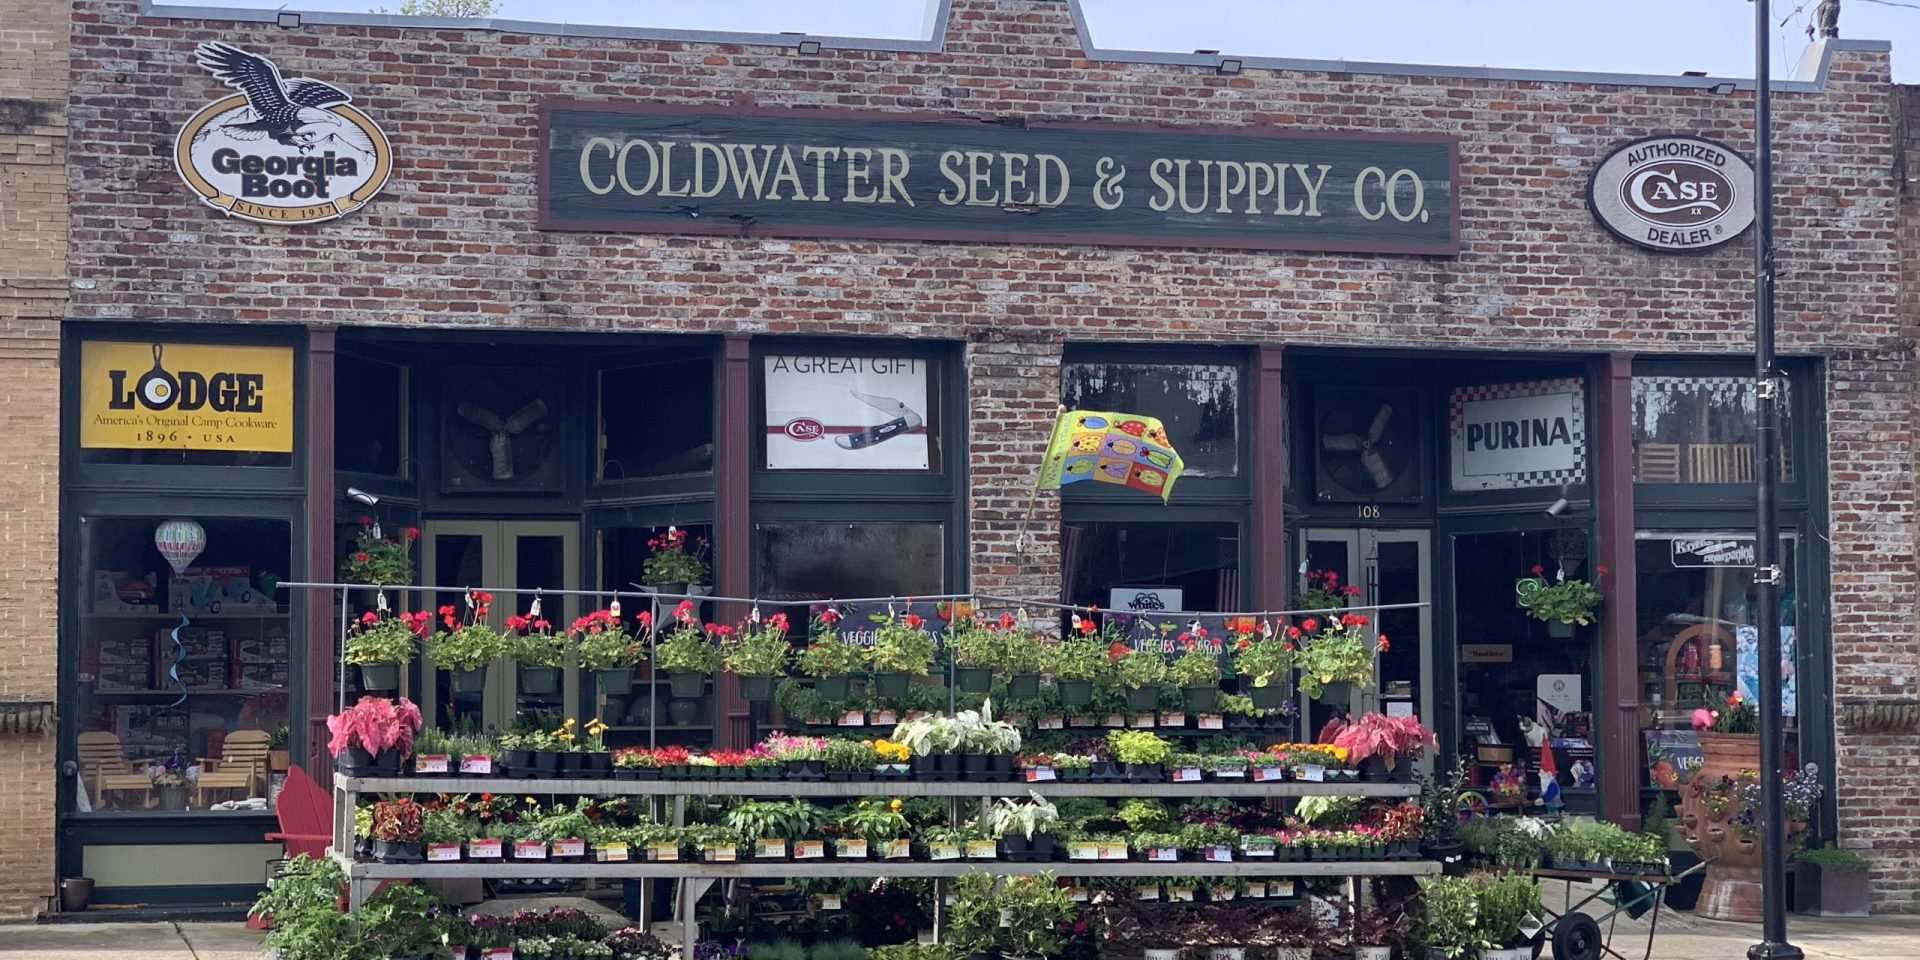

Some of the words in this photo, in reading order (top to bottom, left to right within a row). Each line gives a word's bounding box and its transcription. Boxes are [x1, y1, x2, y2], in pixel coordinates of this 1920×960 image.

[211, 147, 358, 179] Georgia
[1627, 142, 1726, 168] AUTHORIZED
[240, 172, 330, 199] Boot
[580, 136, 915, 208] COLDWATER
[938, 150, 1070, 208] SEED
[1092, 156, 1126, 211] &
[1149, 157, 1333, 217] SUPPLY
[1353, 165, 1430, 224] CO.
[1630, 169, 1722, 214] CASE
[236, 202, 289, 219] SINCE
[301, 203, 334, 219] 1937
[1647, 227, 1712, 246] DEALER
[108, 368, 263, 413] LODGE
[93, 413, 144, 427] America's
[146, 414, 189, 428] Original
[191, 416, 224, 429] Camp
[225, 416, 278, 430] Cookware
[1467, 417, 1572, 452] PURINA
[136, 430, 179, 443] 1896
[203, 433, 236, 443] USA
[1357, 505, 1381, 519] 108
